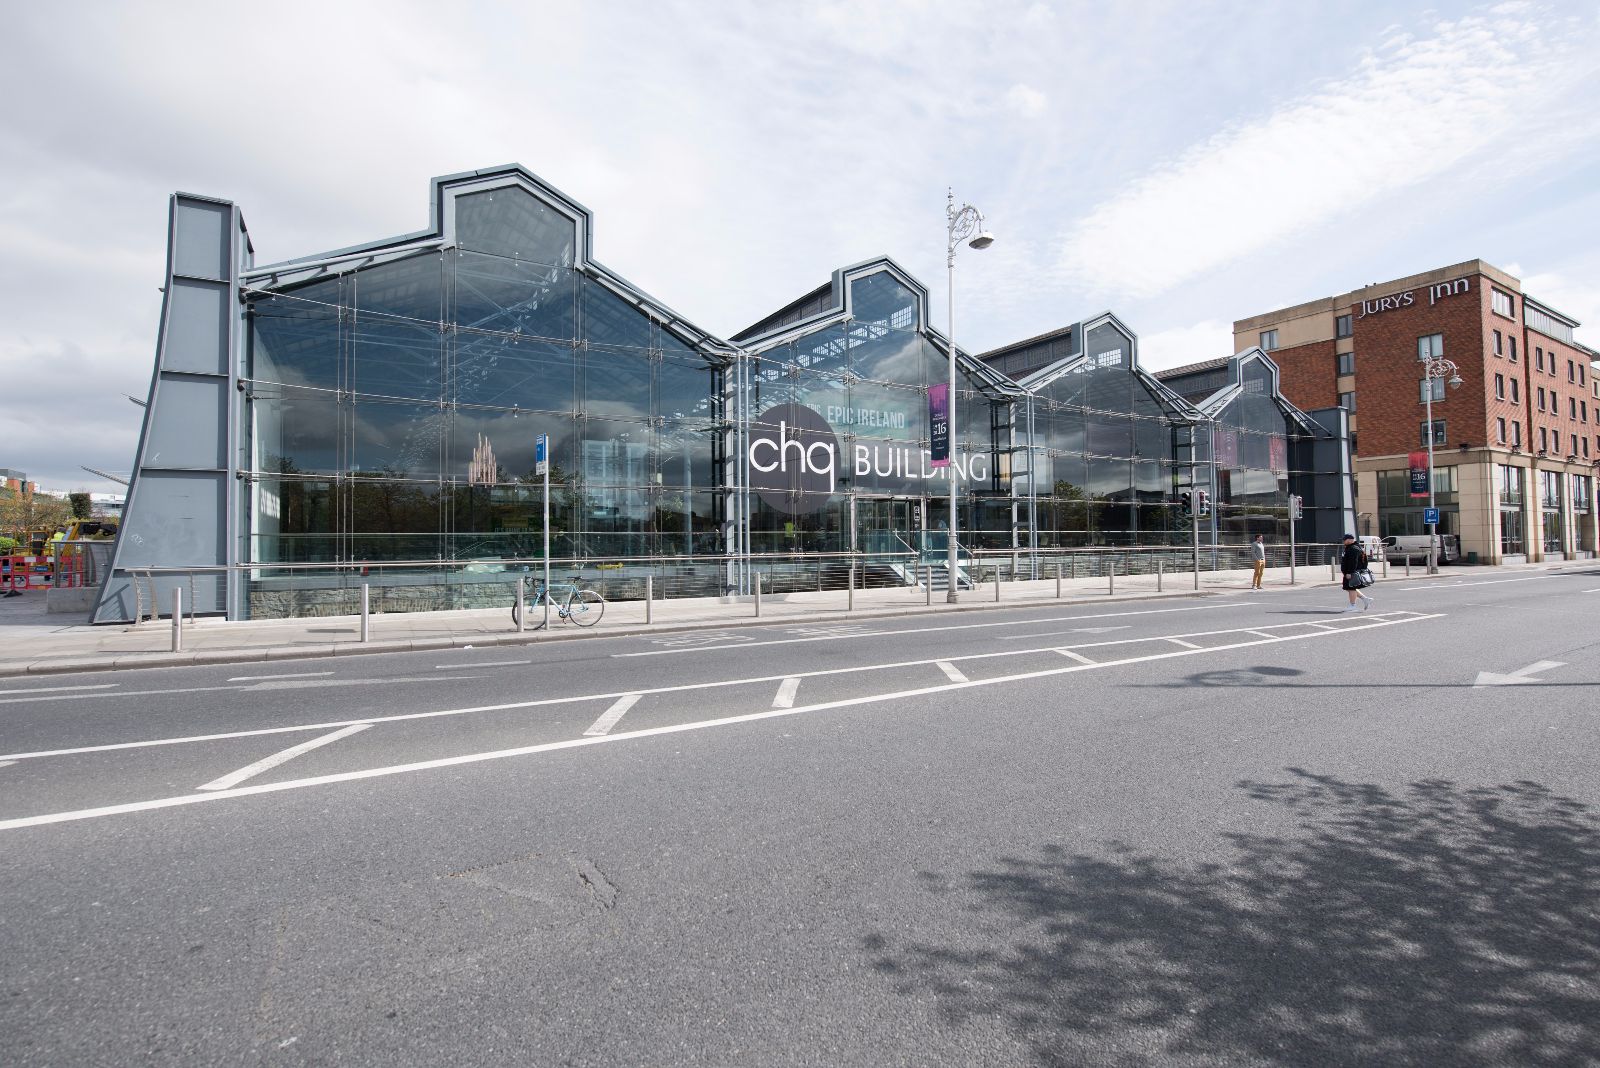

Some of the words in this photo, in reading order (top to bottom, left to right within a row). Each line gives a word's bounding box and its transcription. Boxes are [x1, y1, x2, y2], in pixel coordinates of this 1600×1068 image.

[1358, 292, 1414, 319] JURYS
[1430, 278, 1469, 305] Inn
[827, 405, 854, 425] EPIC
[857, 408, 905, 429] IRELAND
[750, 420, 835, 494] chq
